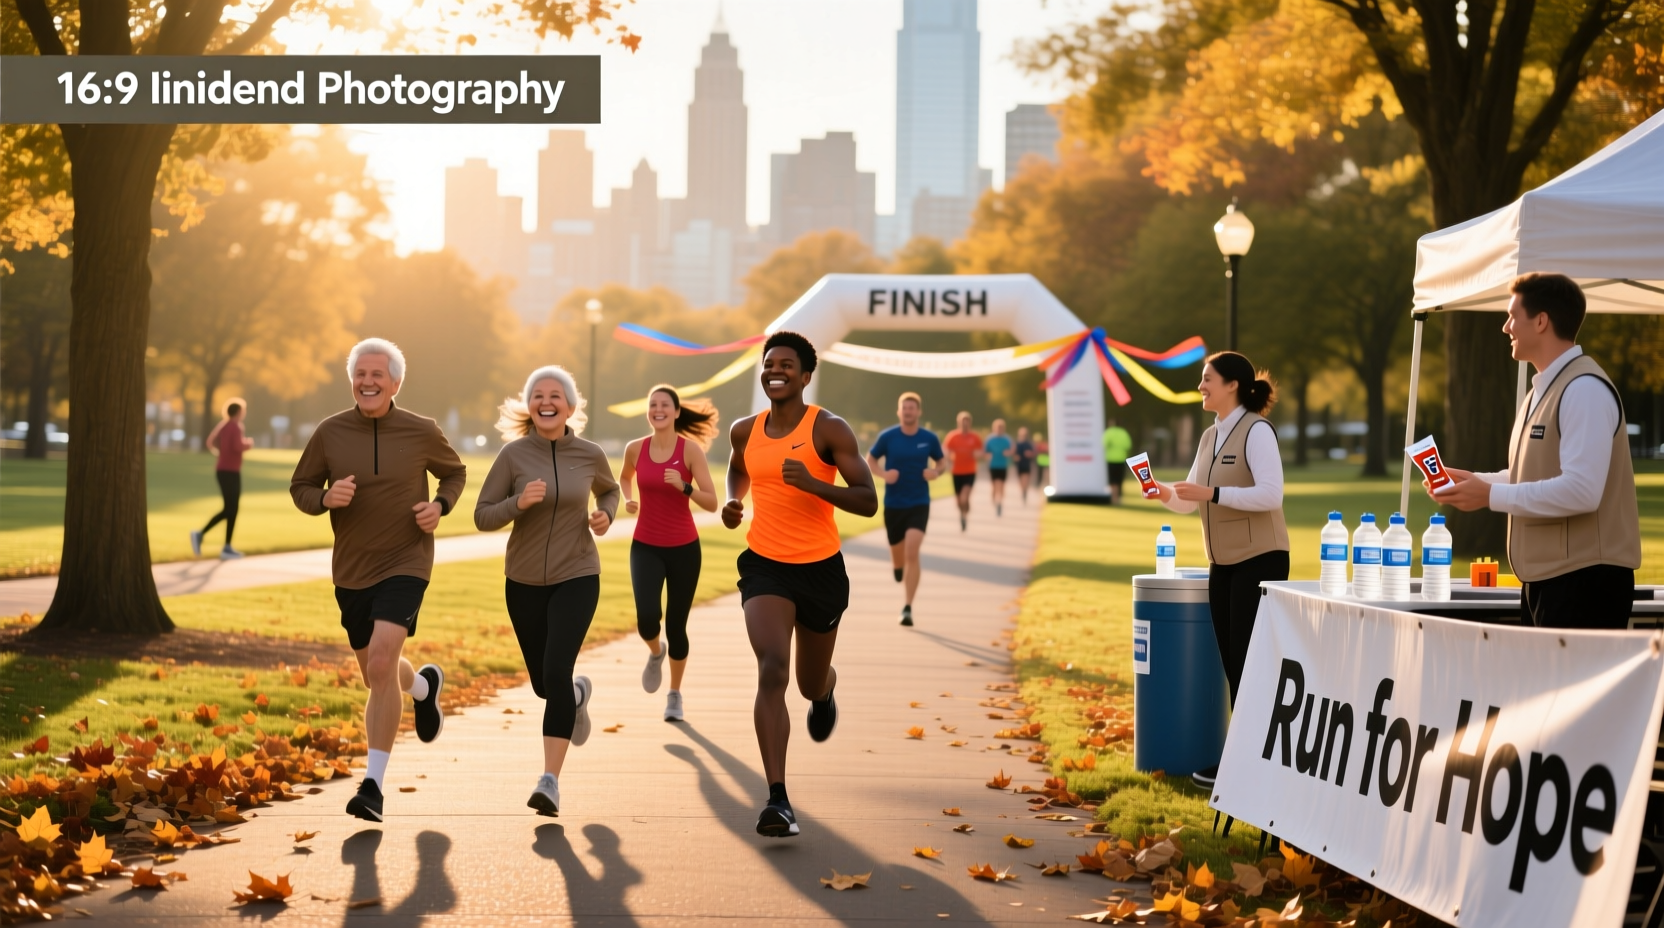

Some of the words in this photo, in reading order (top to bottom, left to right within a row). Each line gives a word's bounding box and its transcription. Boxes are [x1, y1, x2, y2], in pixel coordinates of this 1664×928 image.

[869, 290, 987, 316] FINISH
[1262, 657, 1354, 788] Run
[1358, 677, 1440, 814] for
[1435, 699, 1617, 894] Hope
